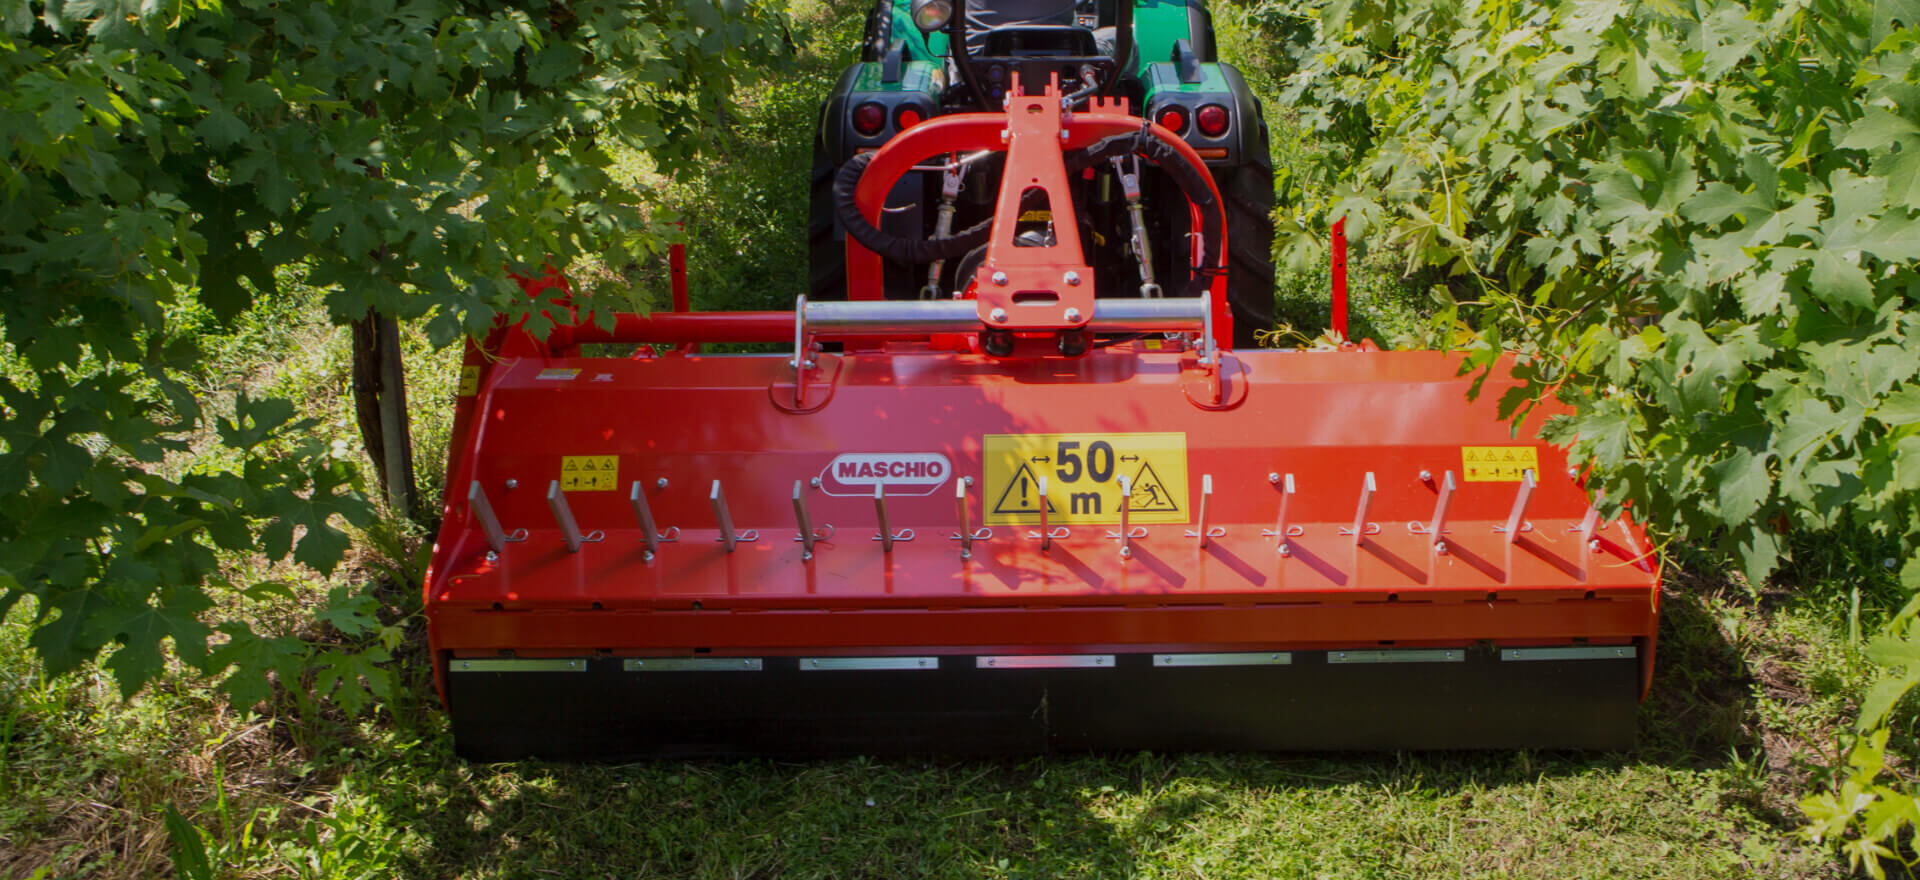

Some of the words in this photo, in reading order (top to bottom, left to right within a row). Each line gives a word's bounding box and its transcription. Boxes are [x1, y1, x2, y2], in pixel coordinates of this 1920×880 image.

[838, 461, 943, 478] MASCHIO
[1056, 440, 1114, 483] 50
[1070, 492, 1101, 515] m
